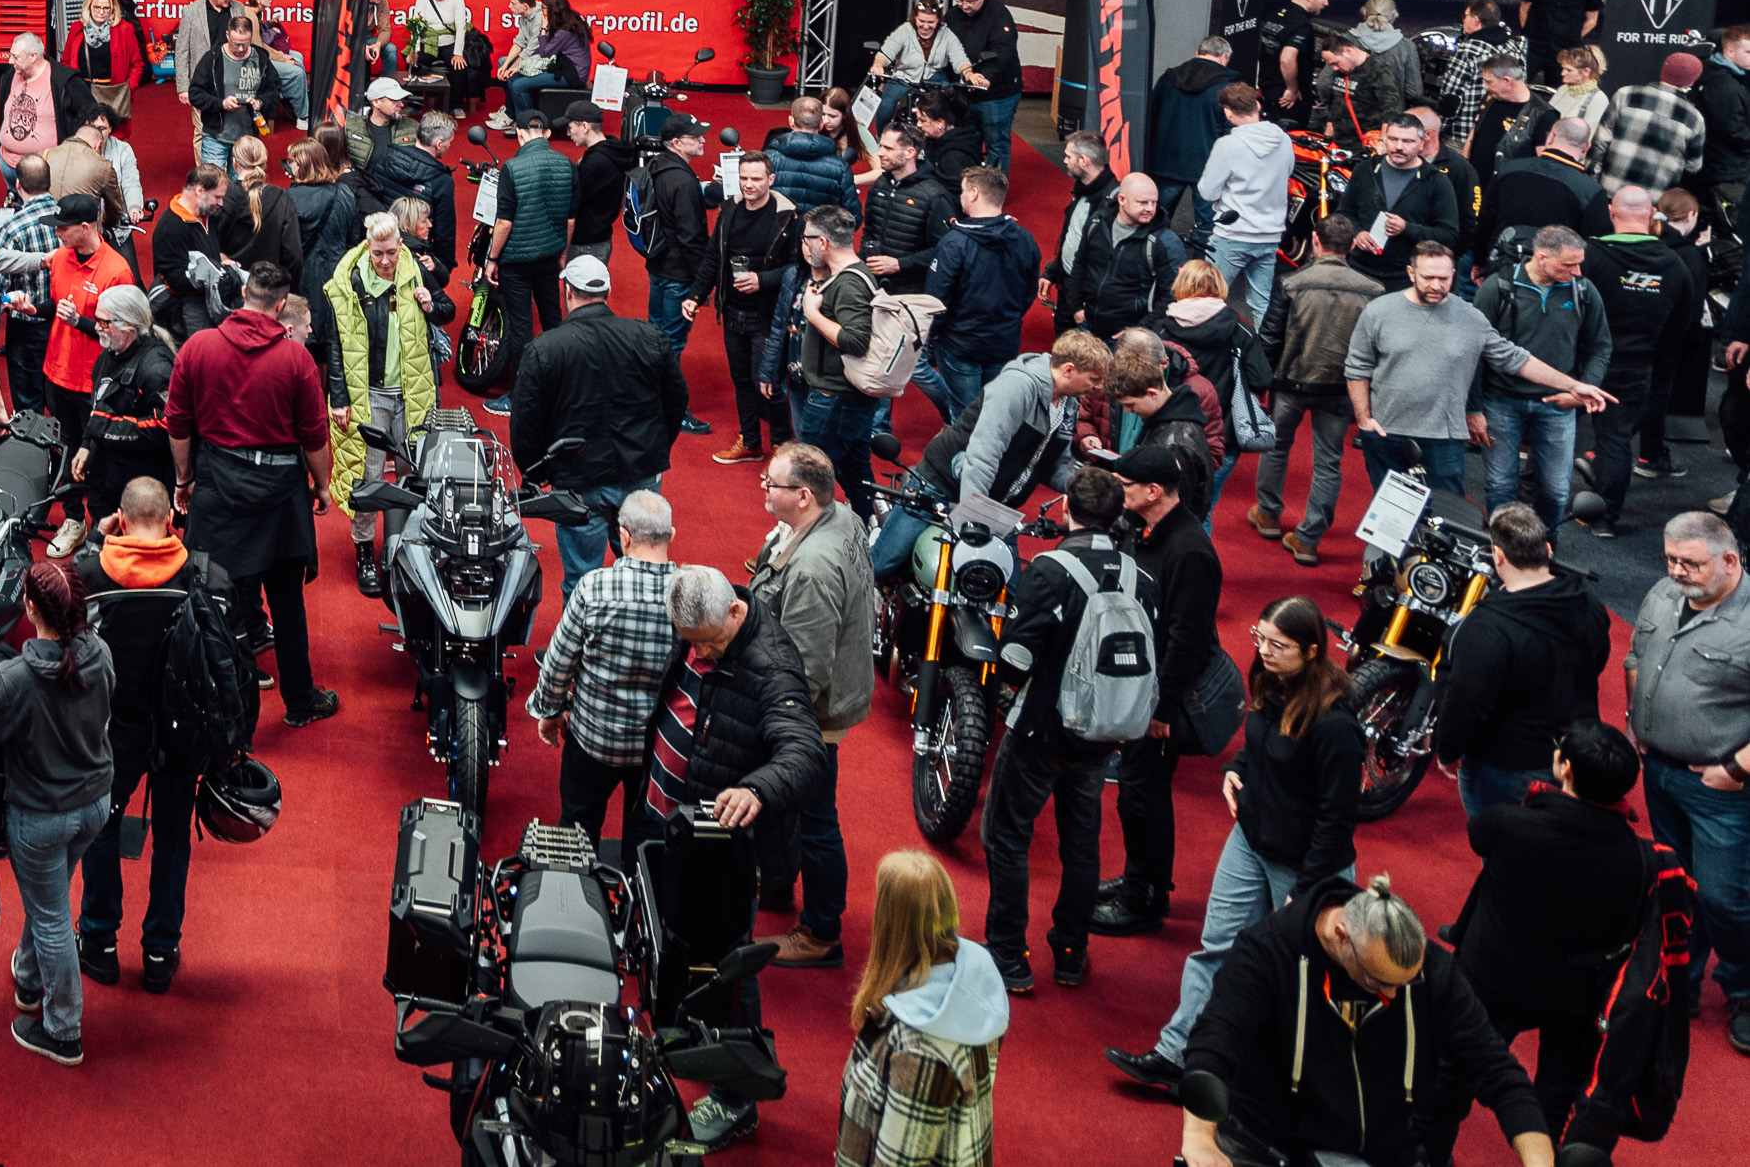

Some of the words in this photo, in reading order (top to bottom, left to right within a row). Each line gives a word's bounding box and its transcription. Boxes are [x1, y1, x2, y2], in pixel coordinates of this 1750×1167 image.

[1616, 32, 1640, 43] FOR
[1643, 33, 1666, 44] THE
[1668, 34, 1690, 45] RID
[240, 67, 261, 80] CAM
[238, 78, 261, 91] DAV
